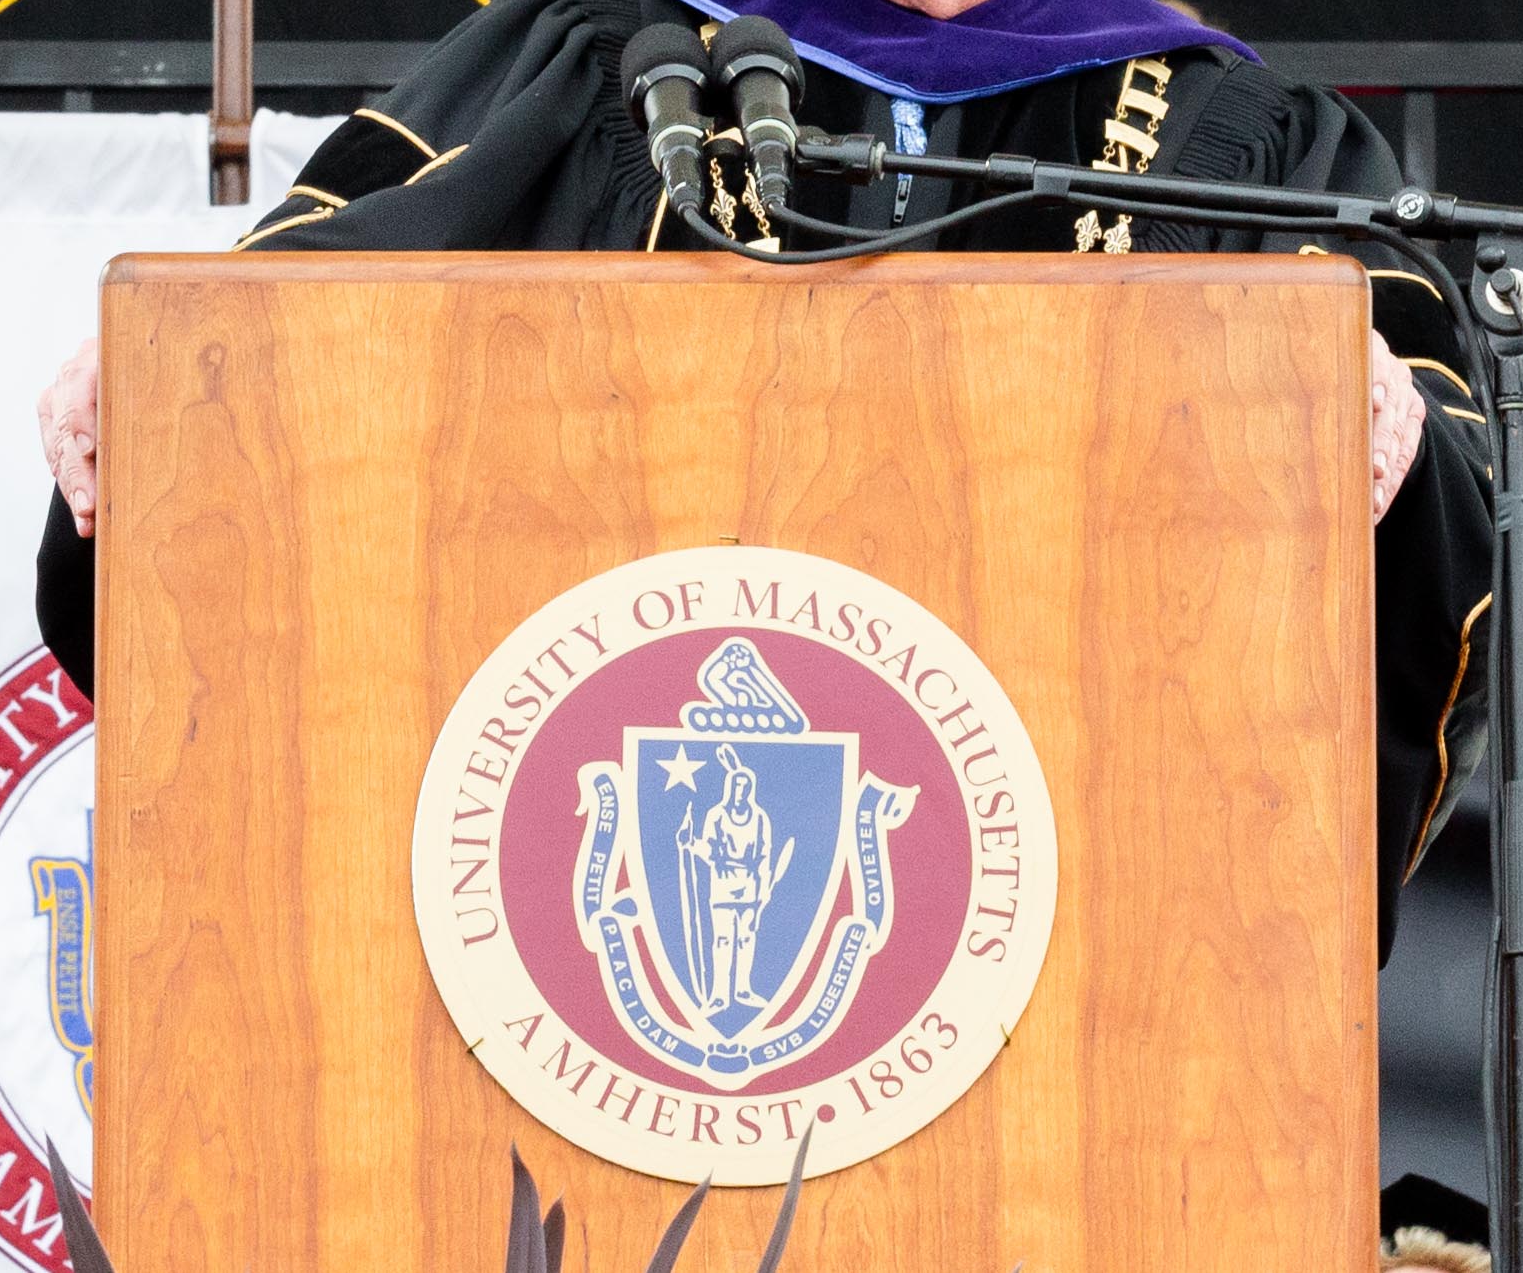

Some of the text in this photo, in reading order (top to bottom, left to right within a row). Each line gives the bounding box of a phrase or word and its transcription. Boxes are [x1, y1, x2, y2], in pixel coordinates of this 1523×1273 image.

[449, 576, 1022, 964] UNIVERSITY OF MASSACHUSETTS
[584, 780, 616, 906] ENSE PETIT
[857, 807, 883, 908] QVIETEM
[603, 923, 680, 1054] PLACIDAM
[761, 923, 868, 1061] SVB LIBERTATE
[502, 1012, 960, 1147] AMHERST 1863
